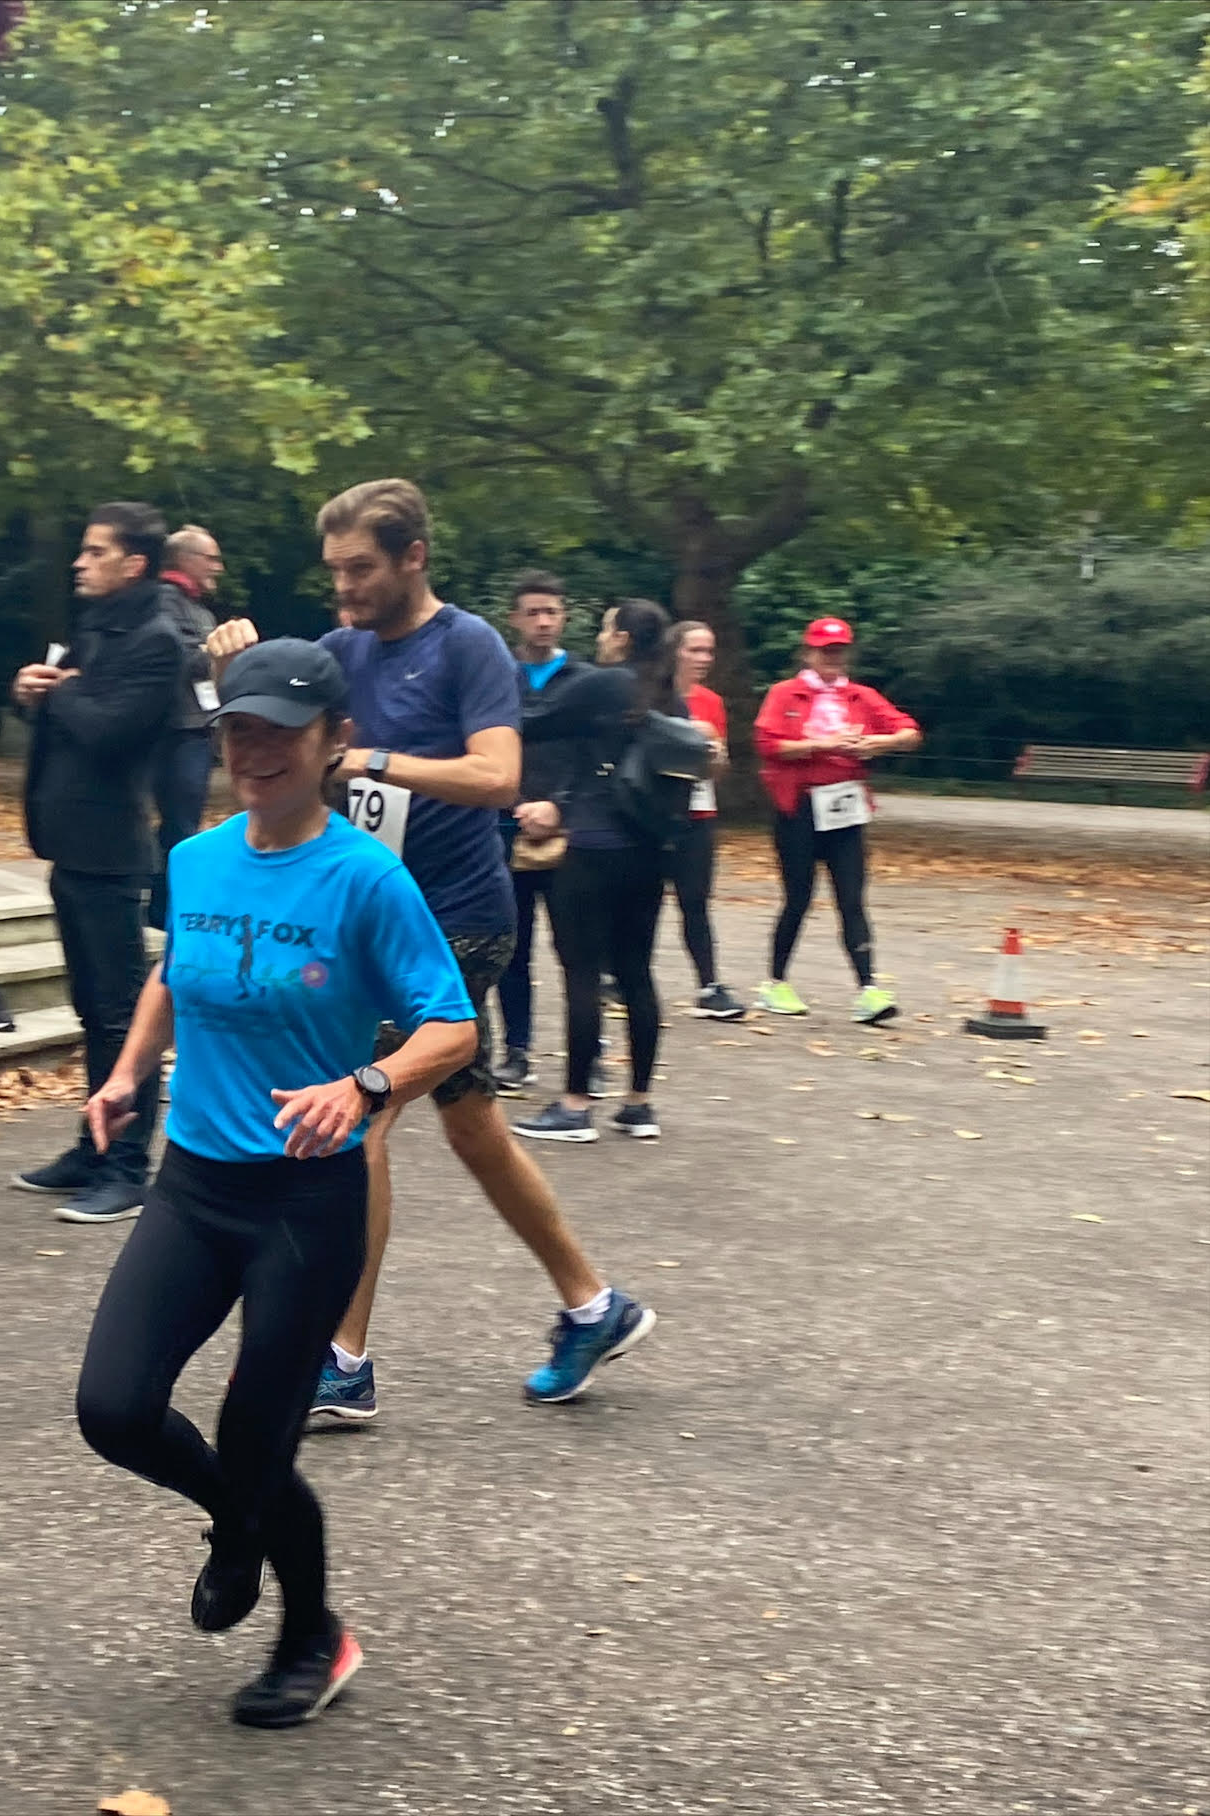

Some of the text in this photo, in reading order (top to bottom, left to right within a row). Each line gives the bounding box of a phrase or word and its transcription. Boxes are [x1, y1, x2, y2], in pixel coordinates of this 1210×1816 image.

[349, 789, 384, 832] 79
[179, 912, 317, 948] TERRY FOX
